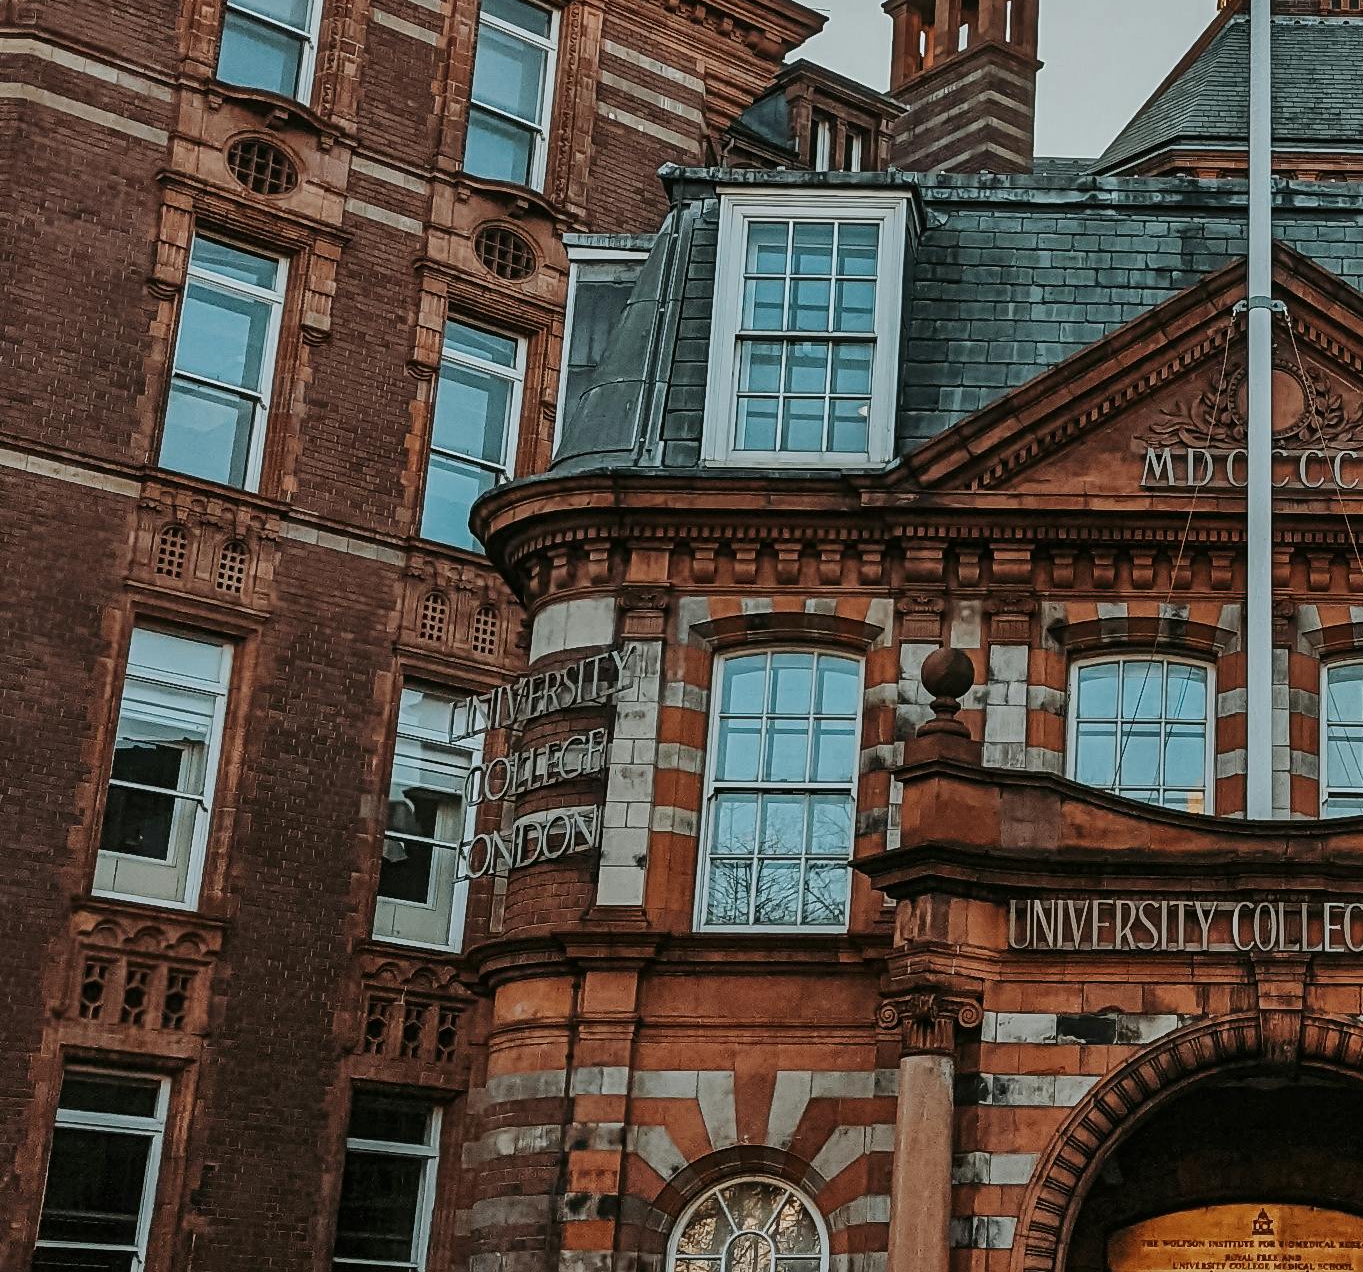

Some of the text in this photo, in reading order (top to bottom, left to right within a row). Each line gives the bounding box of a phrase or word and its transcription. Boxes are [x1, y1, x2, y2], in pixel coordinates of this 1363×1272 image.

[449, 644, 637, 743] UNIVERSITY
[464, 728, 608, 806] COLLEGE
[455, 804, 600, 883] LONDON
[1008, 899, 1216, 951] UNIVERSITY
[1162, 1239, 1205, 1248] WOLFSON
[1208, 1239, 1254, 1248] INSTITUTE
[1258, 1240, 1275, 1248] FOR
[1172, 1261, 1353, 1271] UNIVERSITY COLLEGE MEDICAL SCHOOL
[1225, 1253, 1253, 1261] ROYAL
[1282, 1254, 1301, 1262] AND
